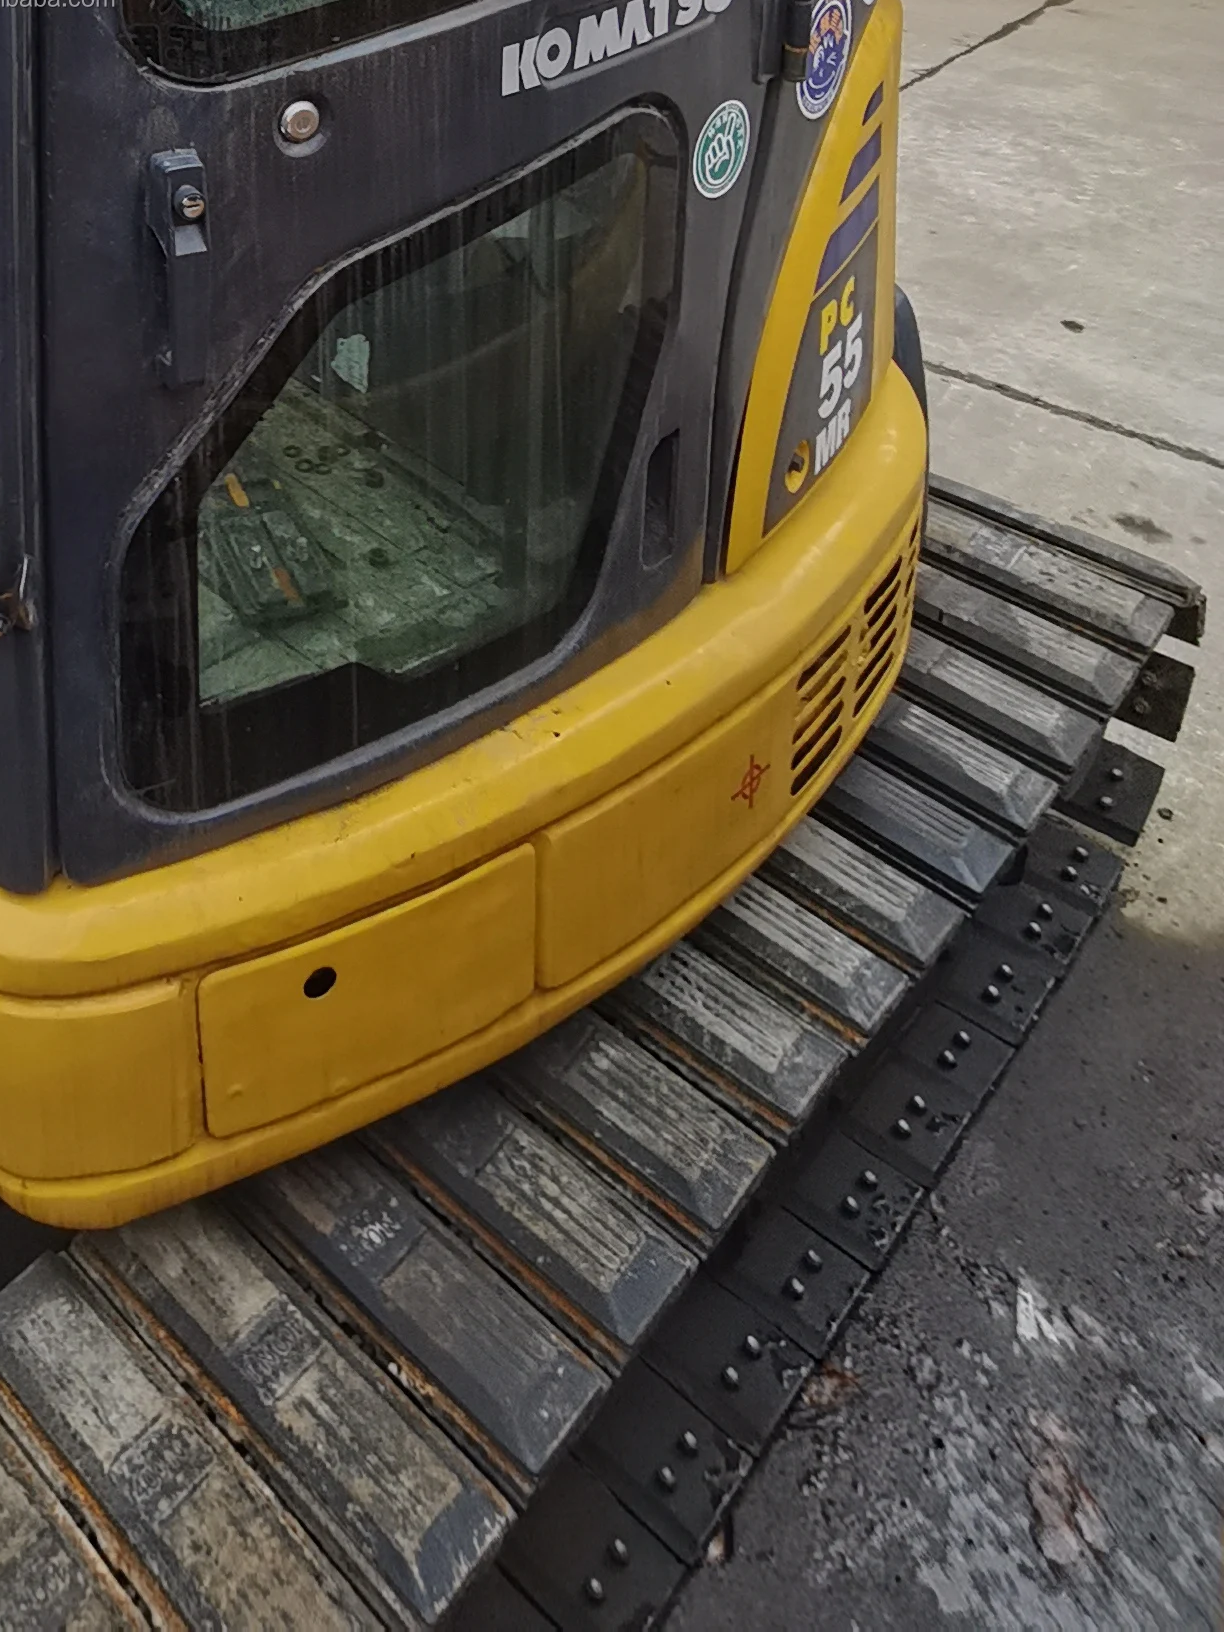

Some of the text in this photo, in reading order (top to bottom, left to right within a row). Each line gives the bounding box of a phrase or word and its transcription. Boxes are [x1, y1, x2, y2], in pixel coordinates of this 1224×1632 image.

[819, 275, 855, 356] PC
[817, 311, 863, 419] 55
[814, 398, 852, 476] MR
